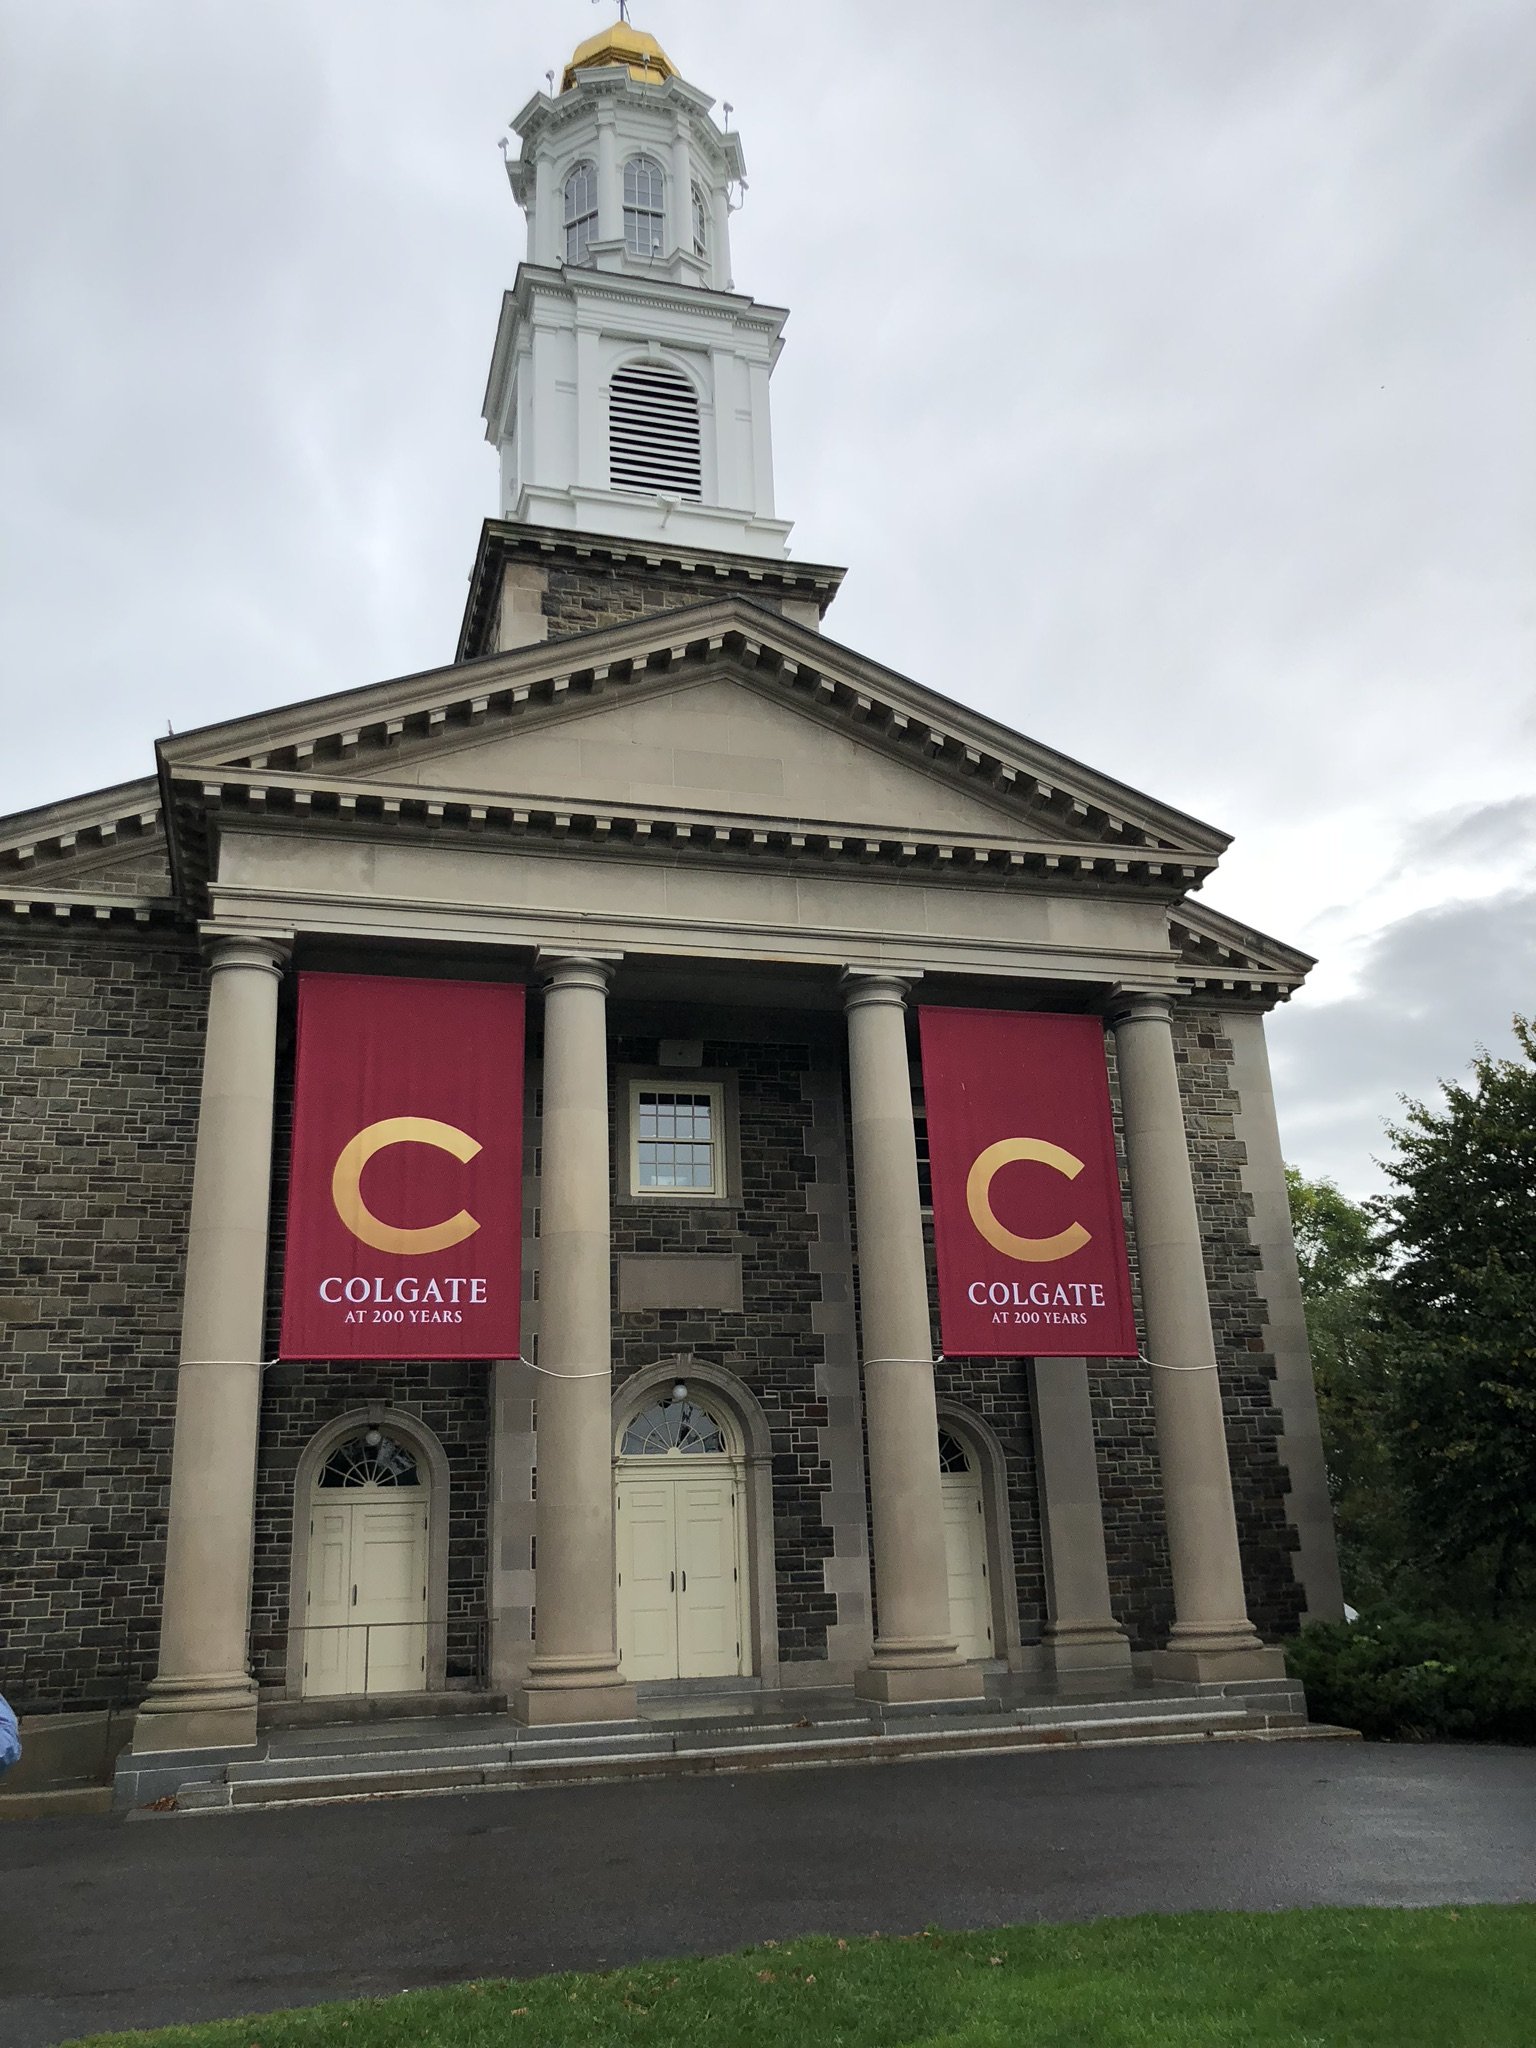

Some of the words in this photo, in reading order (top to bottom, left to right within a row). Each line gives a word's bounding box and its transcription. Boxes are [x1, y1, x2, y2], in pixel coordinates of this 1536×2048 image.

[331, 1116, 484, 1256] C
[966, 1137, 1093, 1263] C
[318, 1277, 489, 1304] COLGATE
[967, 1281, 1106, 1307] COLGATE
[344, 1310, 368, 1324] AT
[372, 1310, 405, 1324] 200
[408, 1310, 463, 1324] YEARS
[991, 1311, 1010, 1324] AT
[1013, 1311, 1040, 1324] 200
[1043, 1311, 1088, 1325] YEARS
